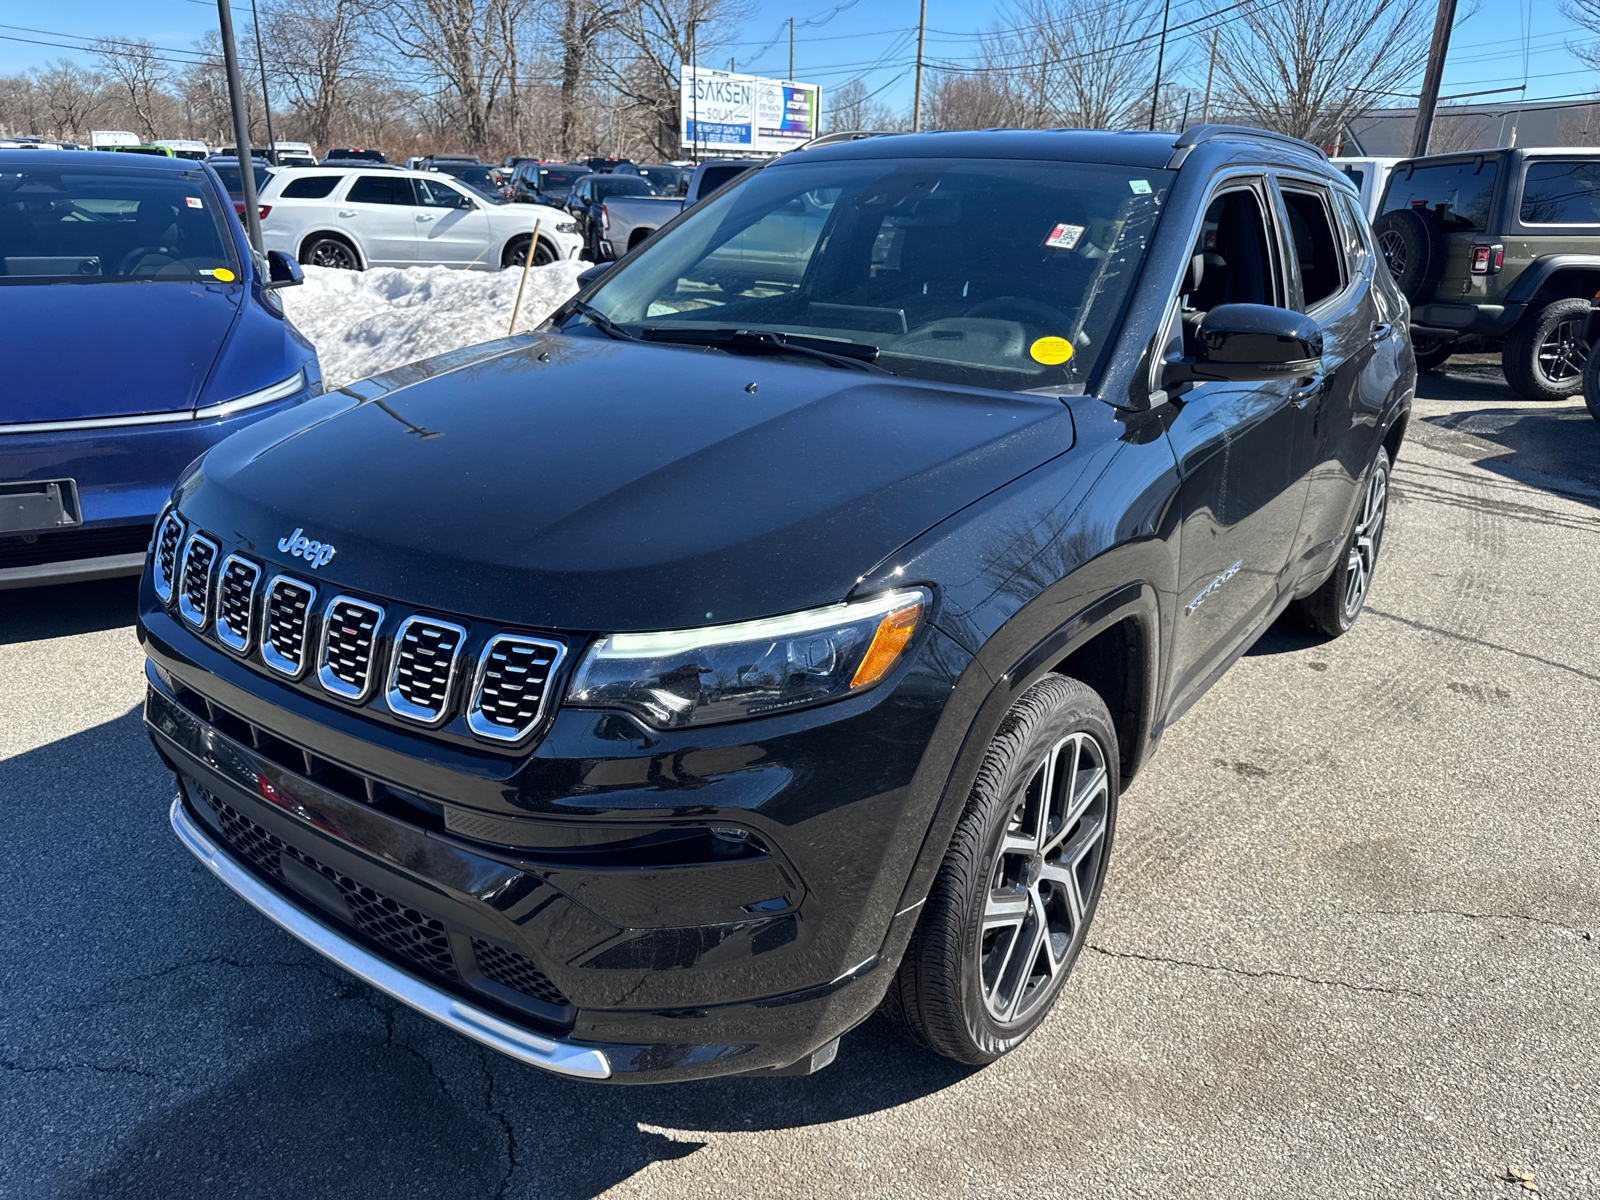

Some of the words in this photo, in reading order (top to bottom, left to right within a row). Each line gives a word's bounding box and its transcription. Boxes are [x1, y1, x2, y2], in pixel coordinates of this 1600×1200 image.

[688, 78, 750, 106] ISAKSEN
[723, 126, 742, 136] QUALITY
[278, 528, 336, 570] Jeep
